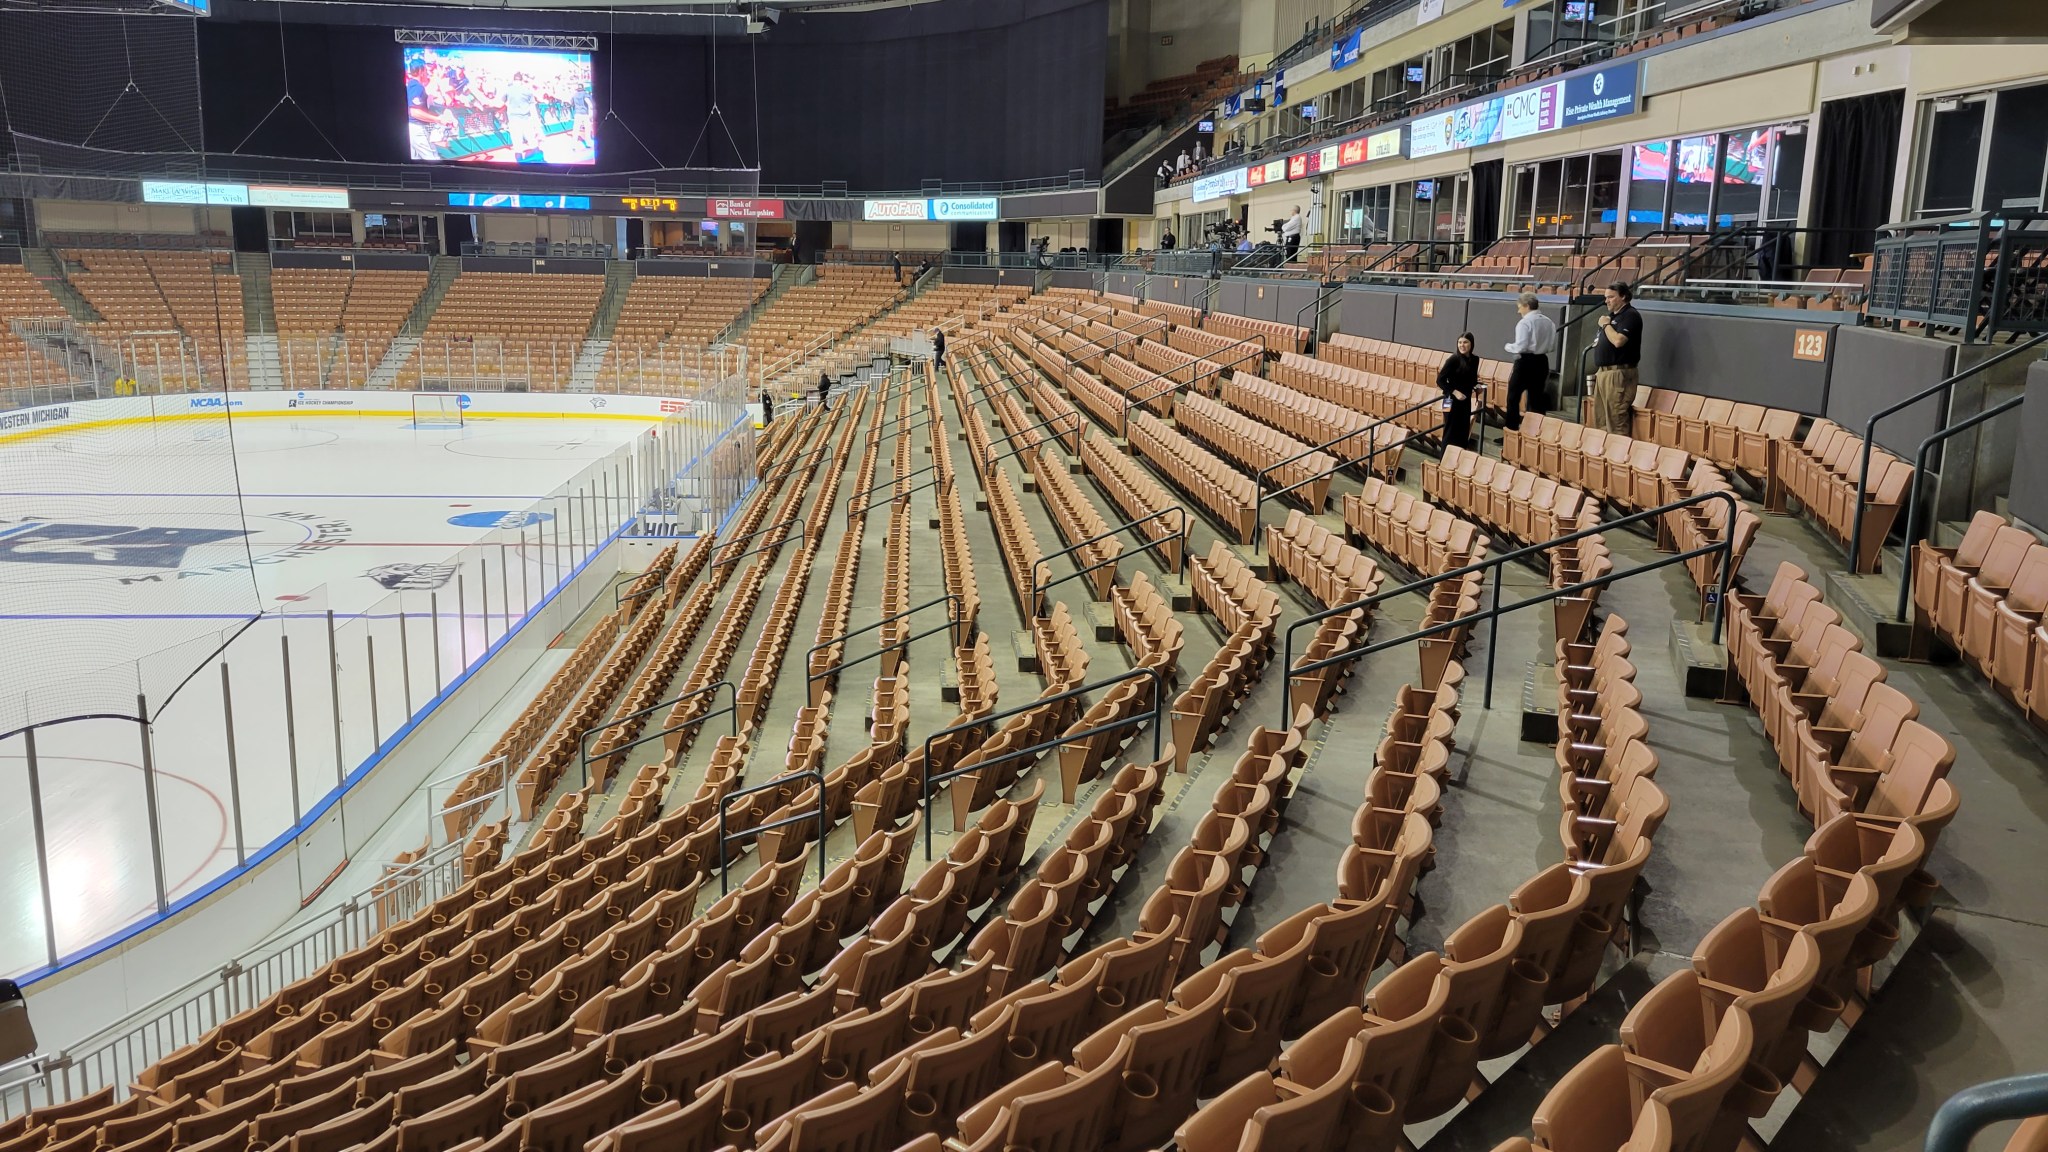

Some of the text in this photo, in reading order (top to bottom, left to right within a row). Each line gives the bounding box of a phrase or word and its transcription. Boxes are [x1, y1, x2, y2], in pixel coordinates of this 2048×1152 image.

[1512, 92, 1537, 119] CMC
[729, 200, 752, 208] Bank of
[951, 201, 994, 210] Consolidated
[730, 208, 775, 217] New Hampshire
[1797, 334, 1823, 357] 123
[31, 406, 69, 424] MICHIGAN
